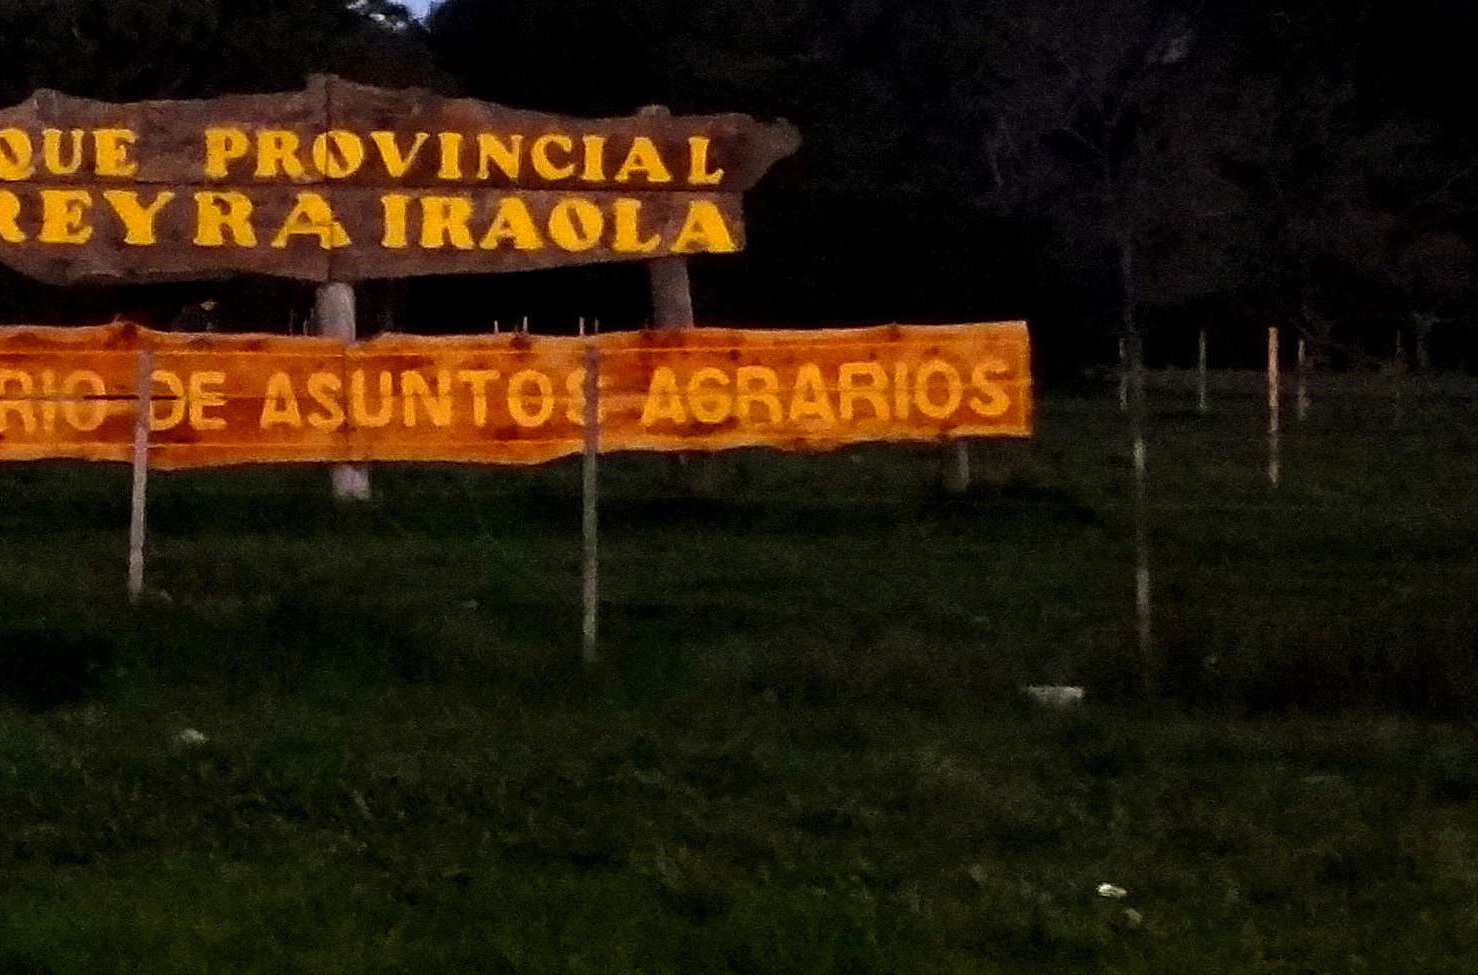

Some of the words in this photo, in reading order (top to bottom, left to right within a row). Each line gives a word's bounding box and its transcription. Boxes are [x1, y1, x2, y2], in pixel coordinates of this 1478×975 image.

[204, 127, 724, 185] PROVINCIAL
[379, 192, 736, 253] IRAOLA
[143, 369, 228, 432] DE
[259, 368, 607, 430] ASUNTOS
[644, 358, 1011, 426] AGRARIOS
